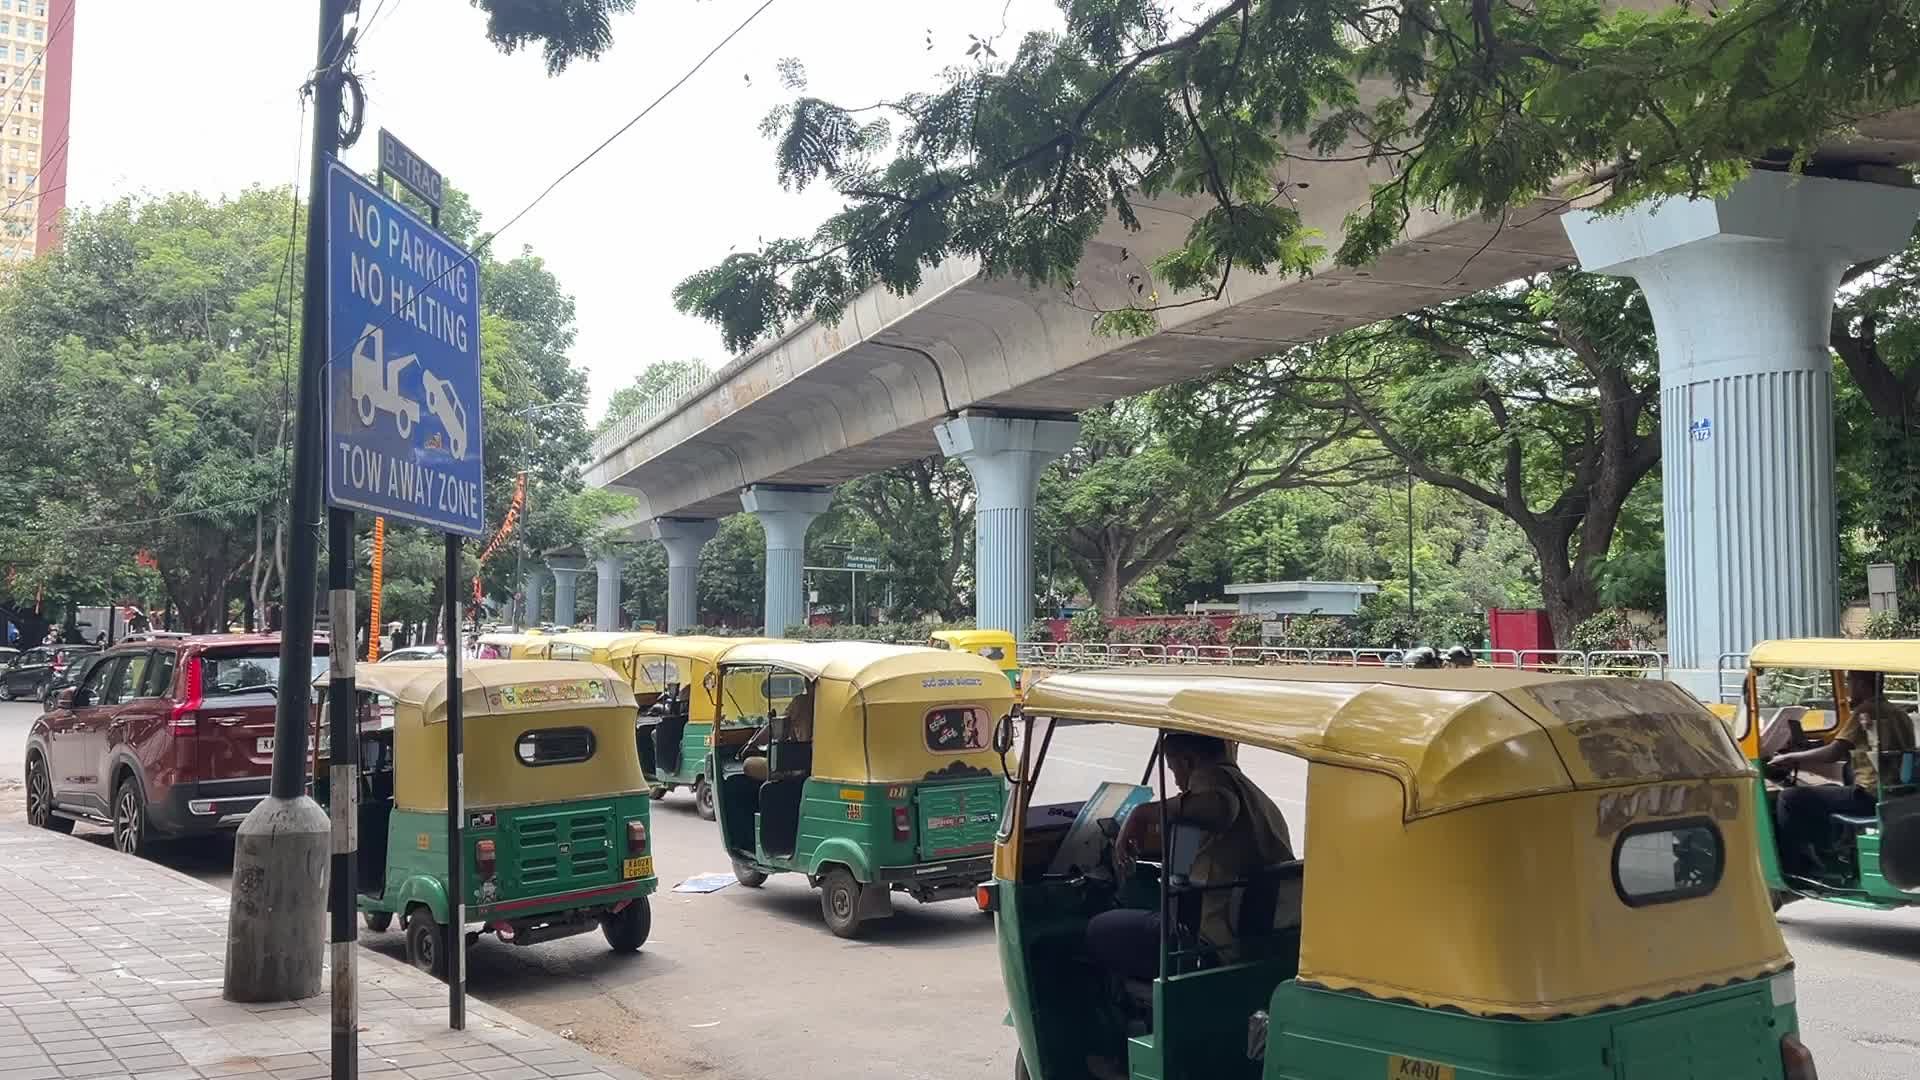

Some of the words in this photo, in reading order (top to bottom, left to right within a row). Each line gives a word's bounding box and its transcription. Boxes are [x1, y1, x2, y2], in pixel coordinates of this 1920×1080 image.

[385, 137, 441, 200] B-TRAC
[349, 191, 381, 248] NO
[389, 218, 467, 304] PARKING
[351, 251, 383, 306] NO
[391, 274, 467, 352] HALTING
[340, 442, 382, 494] TOW
[388, 457, 434, 508] AWAY
[438, 472, 479, 519] ZONE
